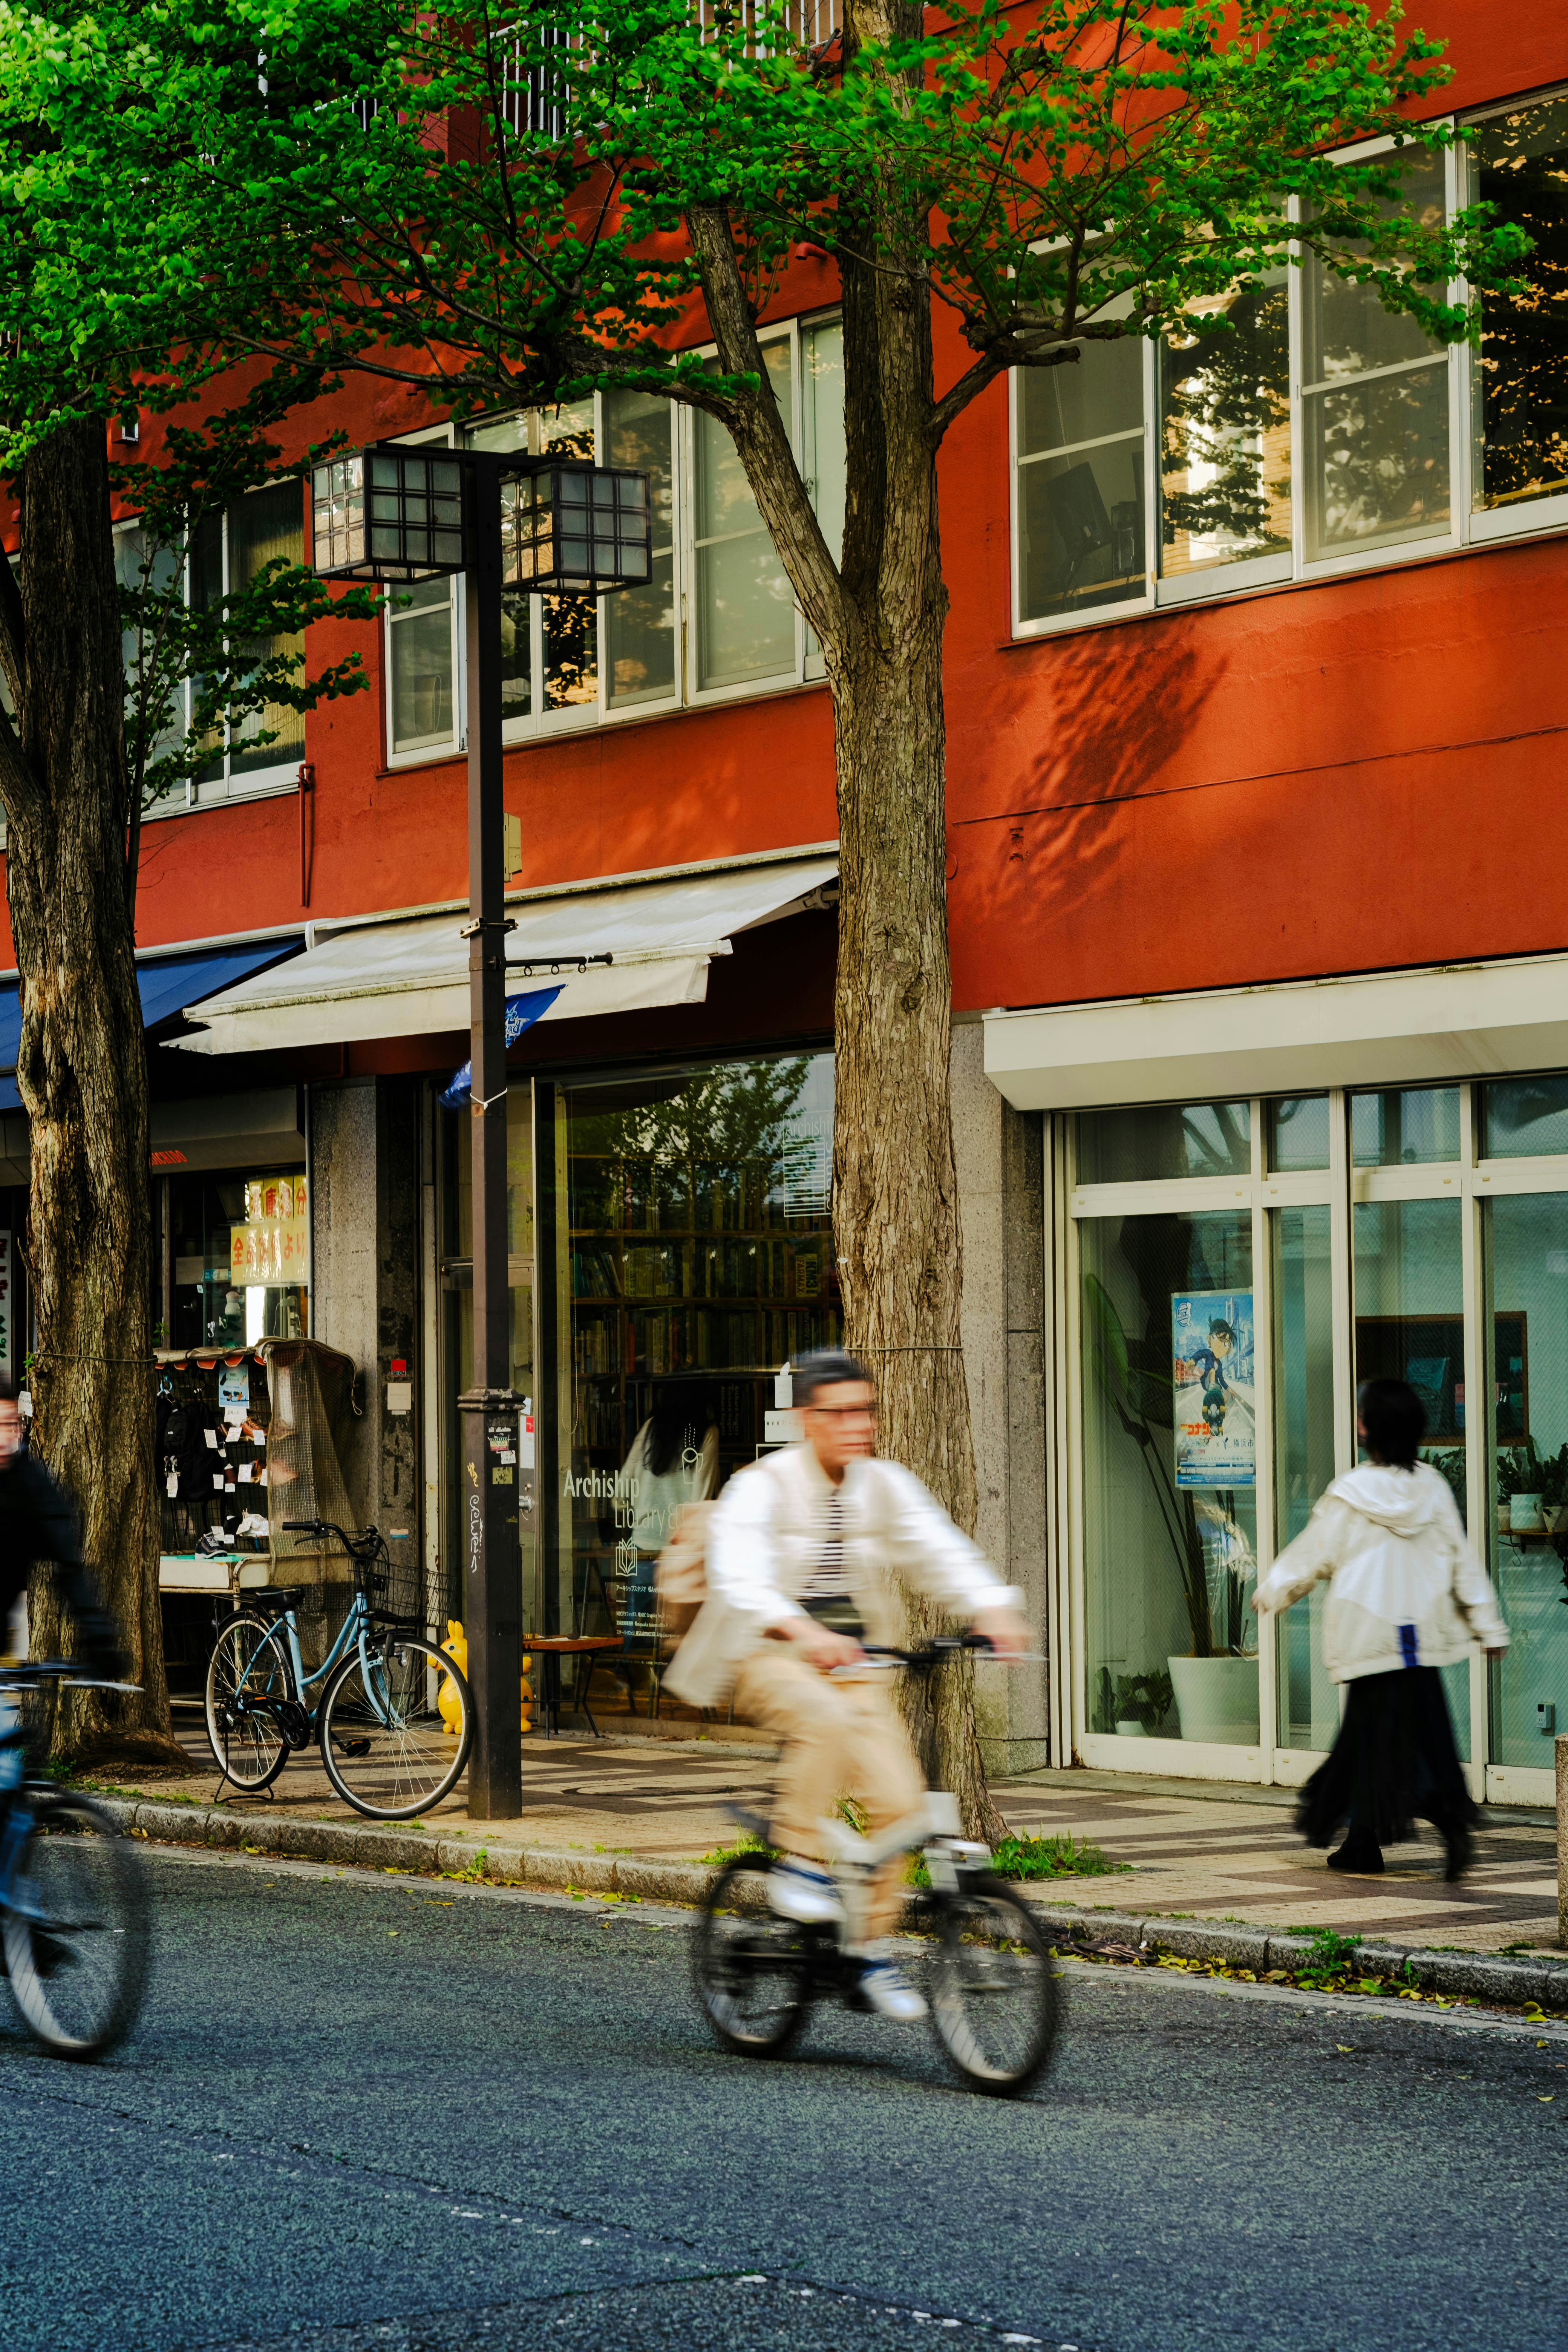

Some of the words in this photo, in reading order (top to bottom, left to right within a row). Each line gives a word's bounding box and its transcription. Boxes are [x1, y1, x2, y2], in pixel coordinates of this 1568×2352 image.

[796, 1259, 805, 1293] FARMAX
[1187, 1423, 1210, 1436] コナン
[1234, 1438, 1254, 1448] 横浜市
[564, 1470, 640, 1506] Archiship
[615, 1500, 665, 1536] Library
